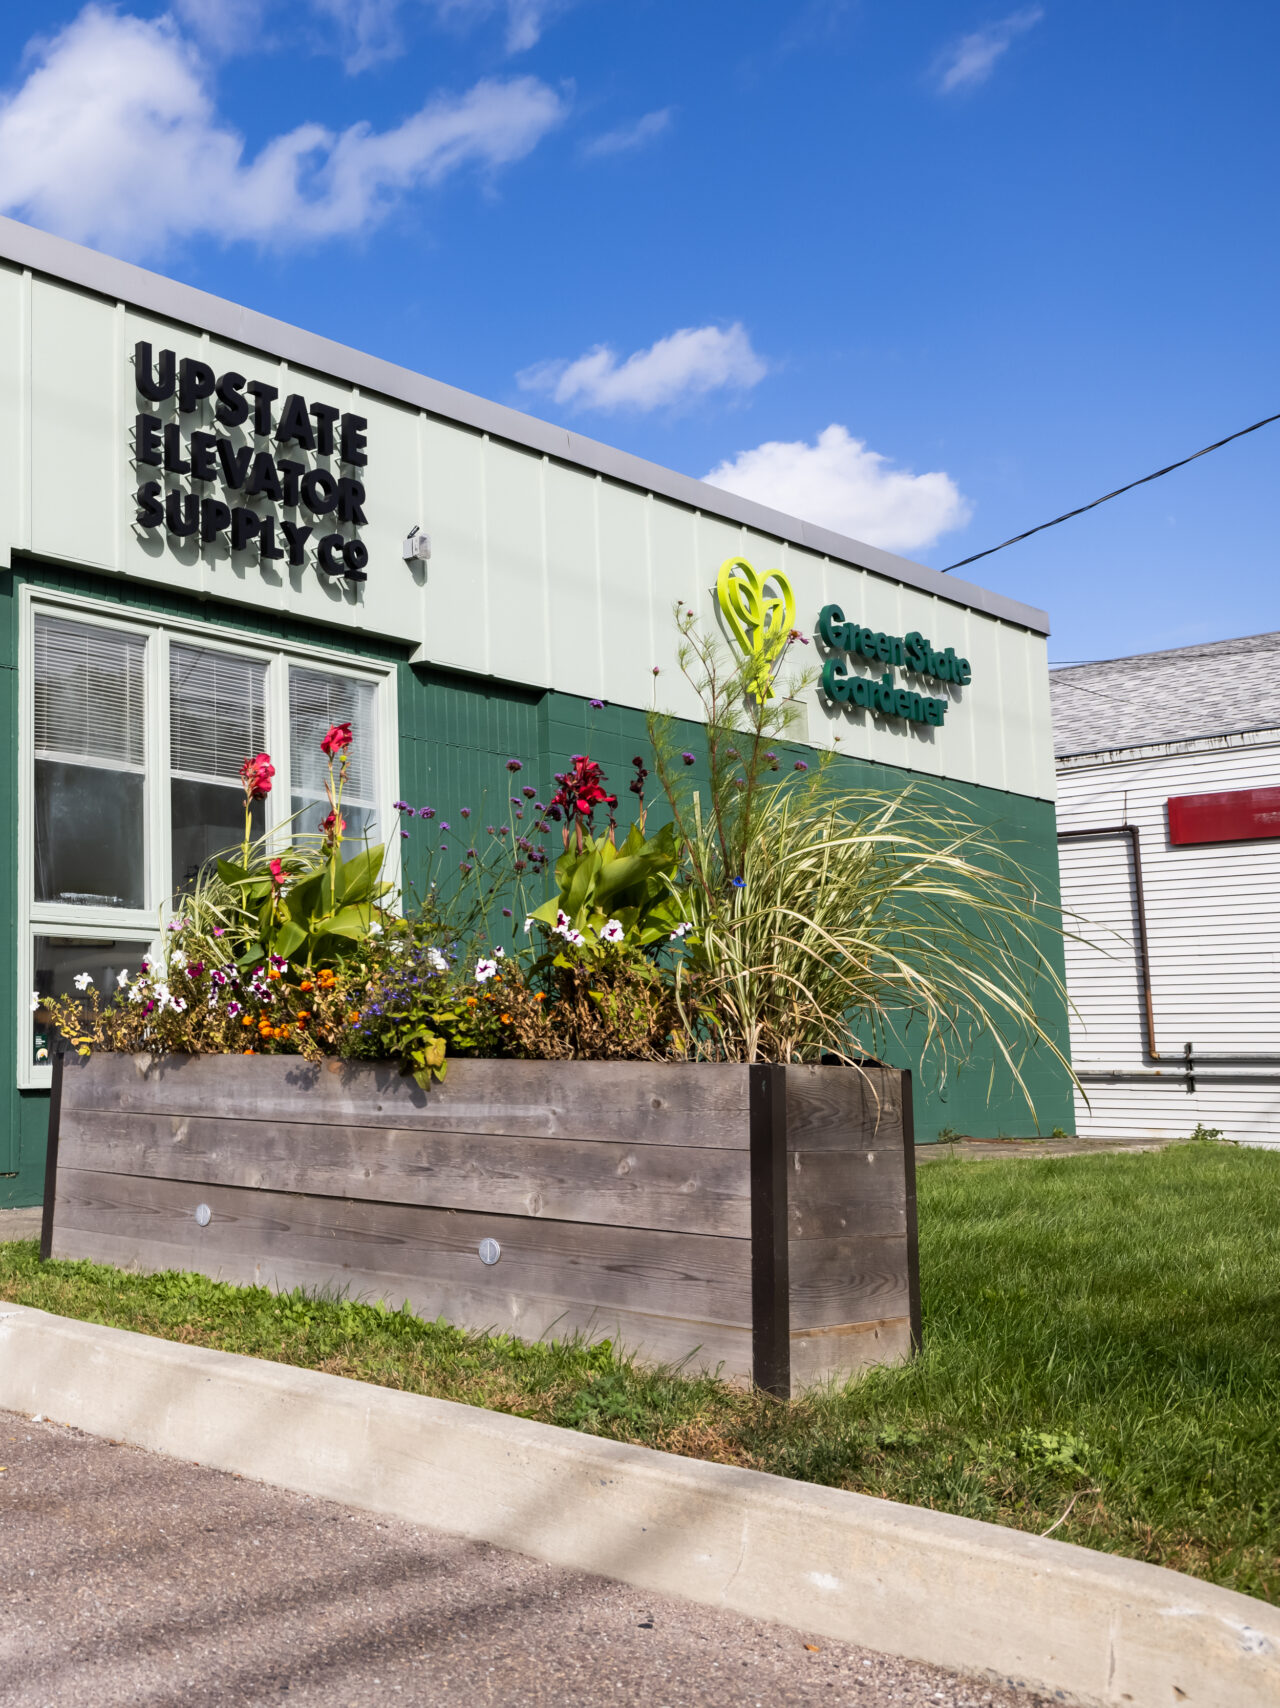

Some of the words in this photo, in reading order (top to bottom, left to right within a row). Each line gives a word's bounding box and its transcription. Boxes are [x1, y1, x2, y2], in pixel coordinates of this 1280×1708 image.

[135, 341, 368, 467] UPSTATE
[135, 413, 369, 526] ELEVATOR
[136, 481, 314, 566] SUPPLY
[819, 604, 906, 666] Green
[905, 631, 972, 686] State
[823, 658, 949, 727] Gardener
